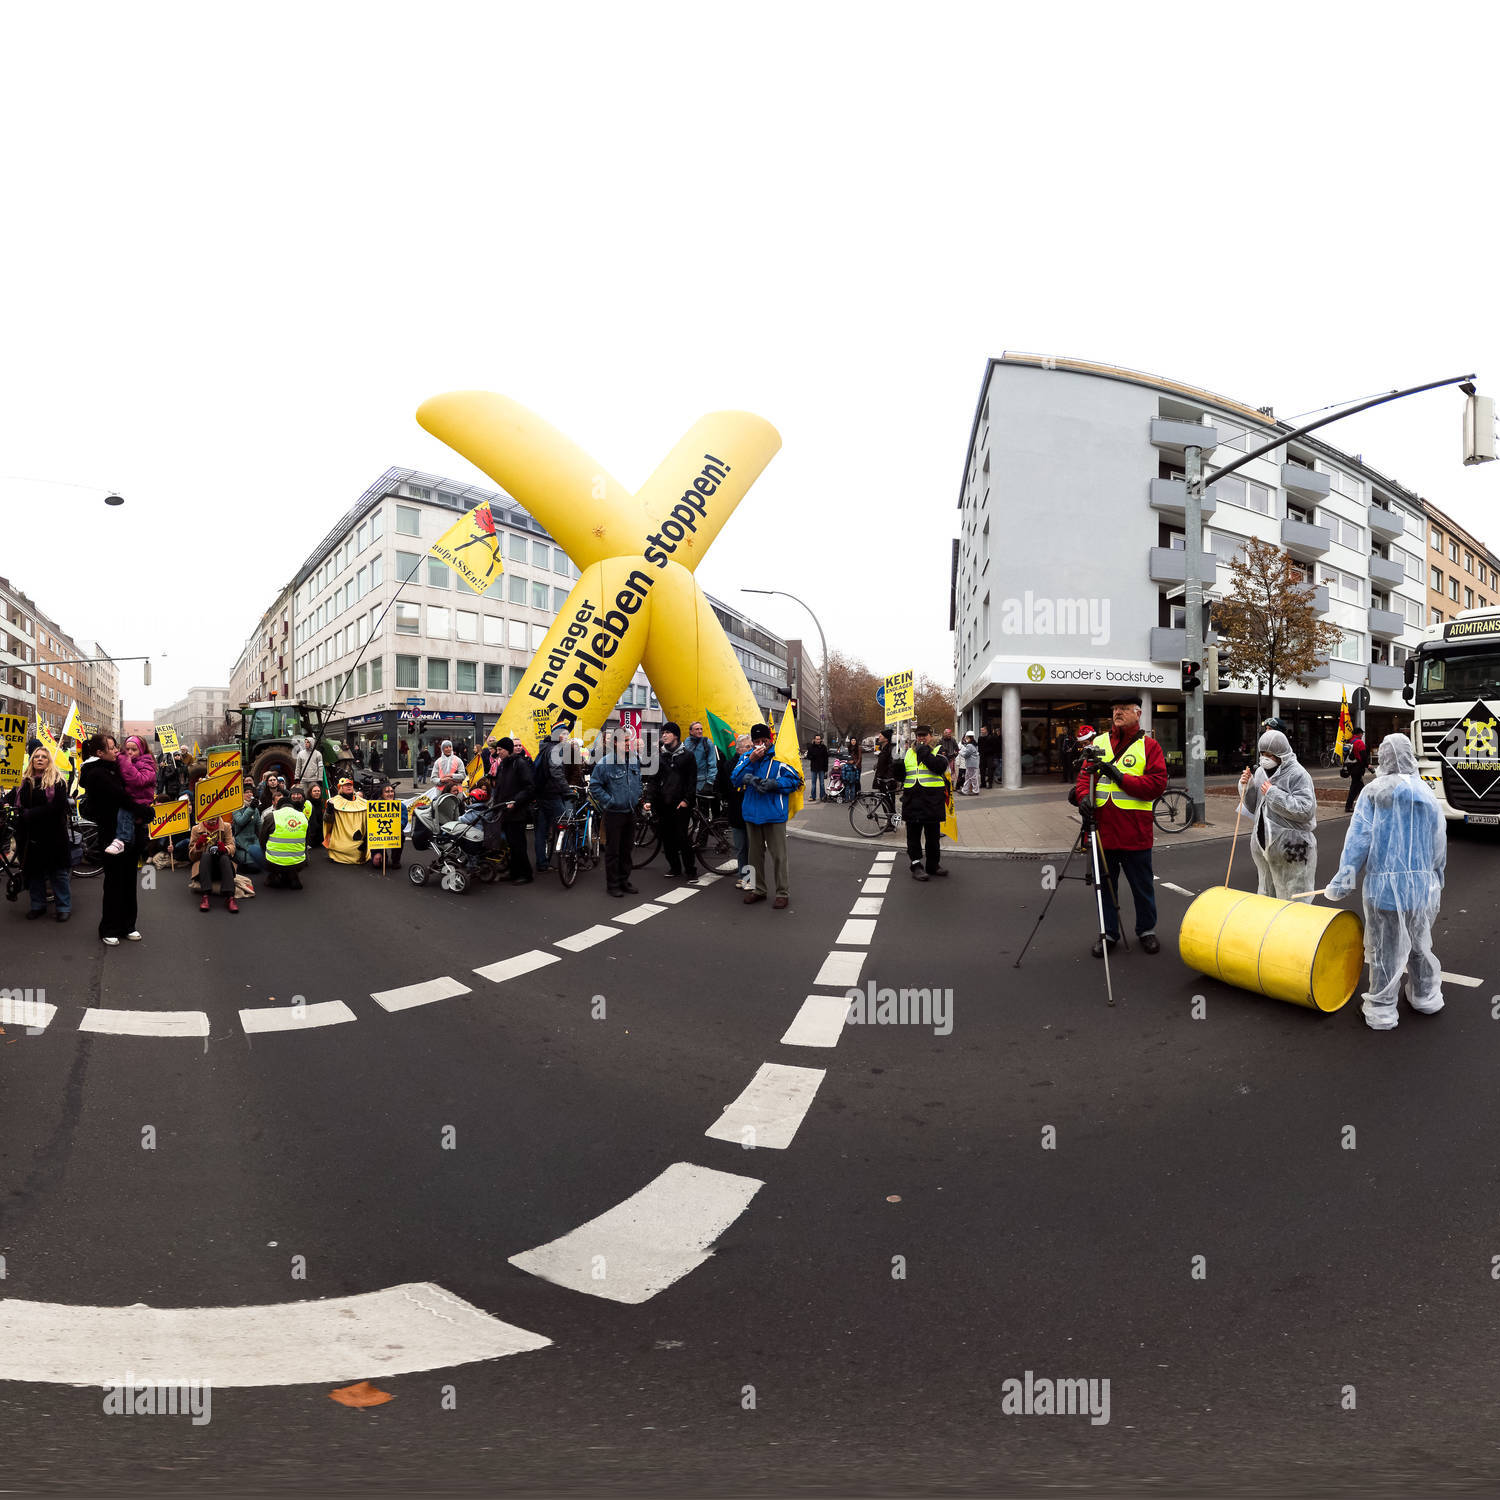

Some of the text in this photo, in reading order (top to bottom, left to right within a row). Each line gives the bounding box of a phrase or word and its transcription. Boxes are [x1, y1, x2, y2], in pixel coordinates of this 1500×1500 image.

[644, 454, 731, 568] stoppen!
[529, 600, 596, 701] Endlager
[886, 671, 912, 688] KEIN
[1050, 668, 1164, 683] sander's backstube
[211, 757, 239, 768] Gorleben
[200, 785, 240, 806] Gorleben
[369, 802, 400, 812] KEIN
[153, 810, 187, 826] Gorleben
